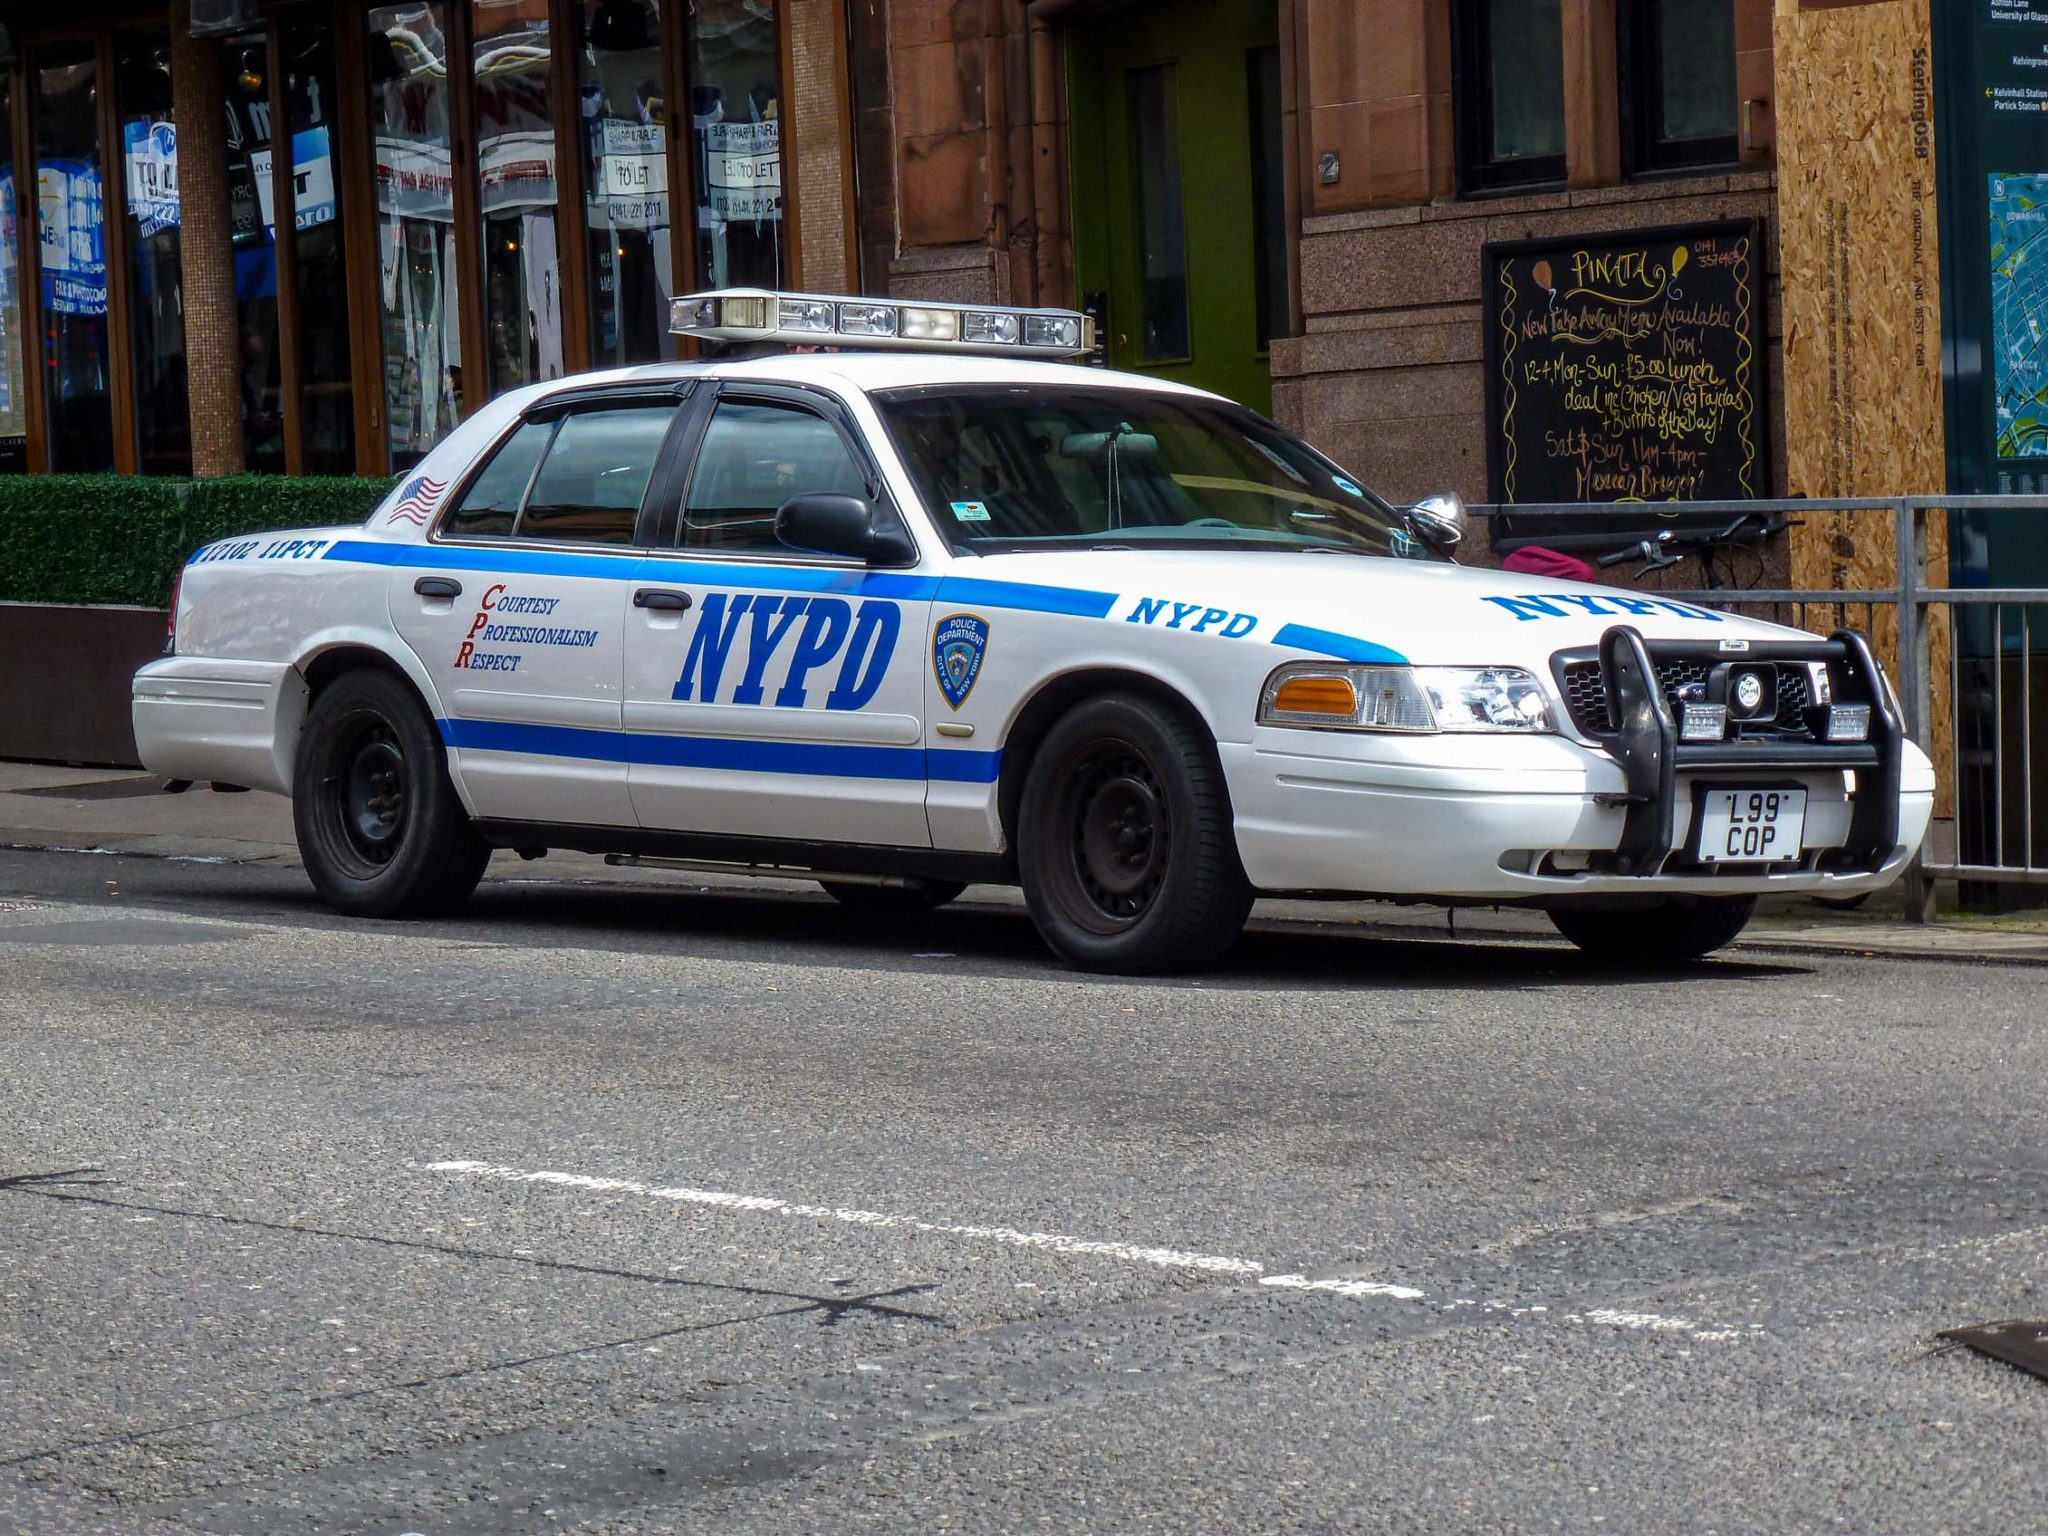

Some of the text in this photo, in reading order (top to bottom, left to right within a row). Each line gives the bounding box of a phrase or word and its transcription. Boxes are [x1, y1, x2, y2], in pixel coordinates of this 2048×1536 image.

[1992, 10, 2022, 22] University
[2023, 12, 2029, 20] of
[1911, 48, 1930, 159] SterlingOSB
[1994, 88, 2048, 98] Kelvinhall Station
[1995, 100, 2017, 110] Partick
[2018, 101, 2040, 110] Station
[633, 165, 649, 185] LET
[1912, 181, 1925, 367] THE ORIGINAL AND BEST OSB
[1522, 310, 1548, 342] New
[1549, 308, 1577, 336] Take
[1656, 301, 1731, 332] Available
[1565, 385, 1604, 413] deal
[1610, 407, 1656, 438] Burrito
[1545, 430, 1578, 457] Sat
[1591, 433, 1630, 471] Sun
[481, 583, 560, 615] COURTESY
[1480, 594, 1724, 621] NYPD
[467, 612, 598, 647] PROFESSIONALISM
[950, 618, 977, 630] POLICE
[1125, 597, 1258, 638] NYPD
[671, 592, 901, 710] NYPD
[937, 629, 985, 647] DEPARTMENT
[453, 641, 521, 671] RESPECT
[937, 652, 981, 698] CITY OF NEW YORK
[1729, 793, 1780, 823] L99
[1726, 826, 1776, 856] COP
